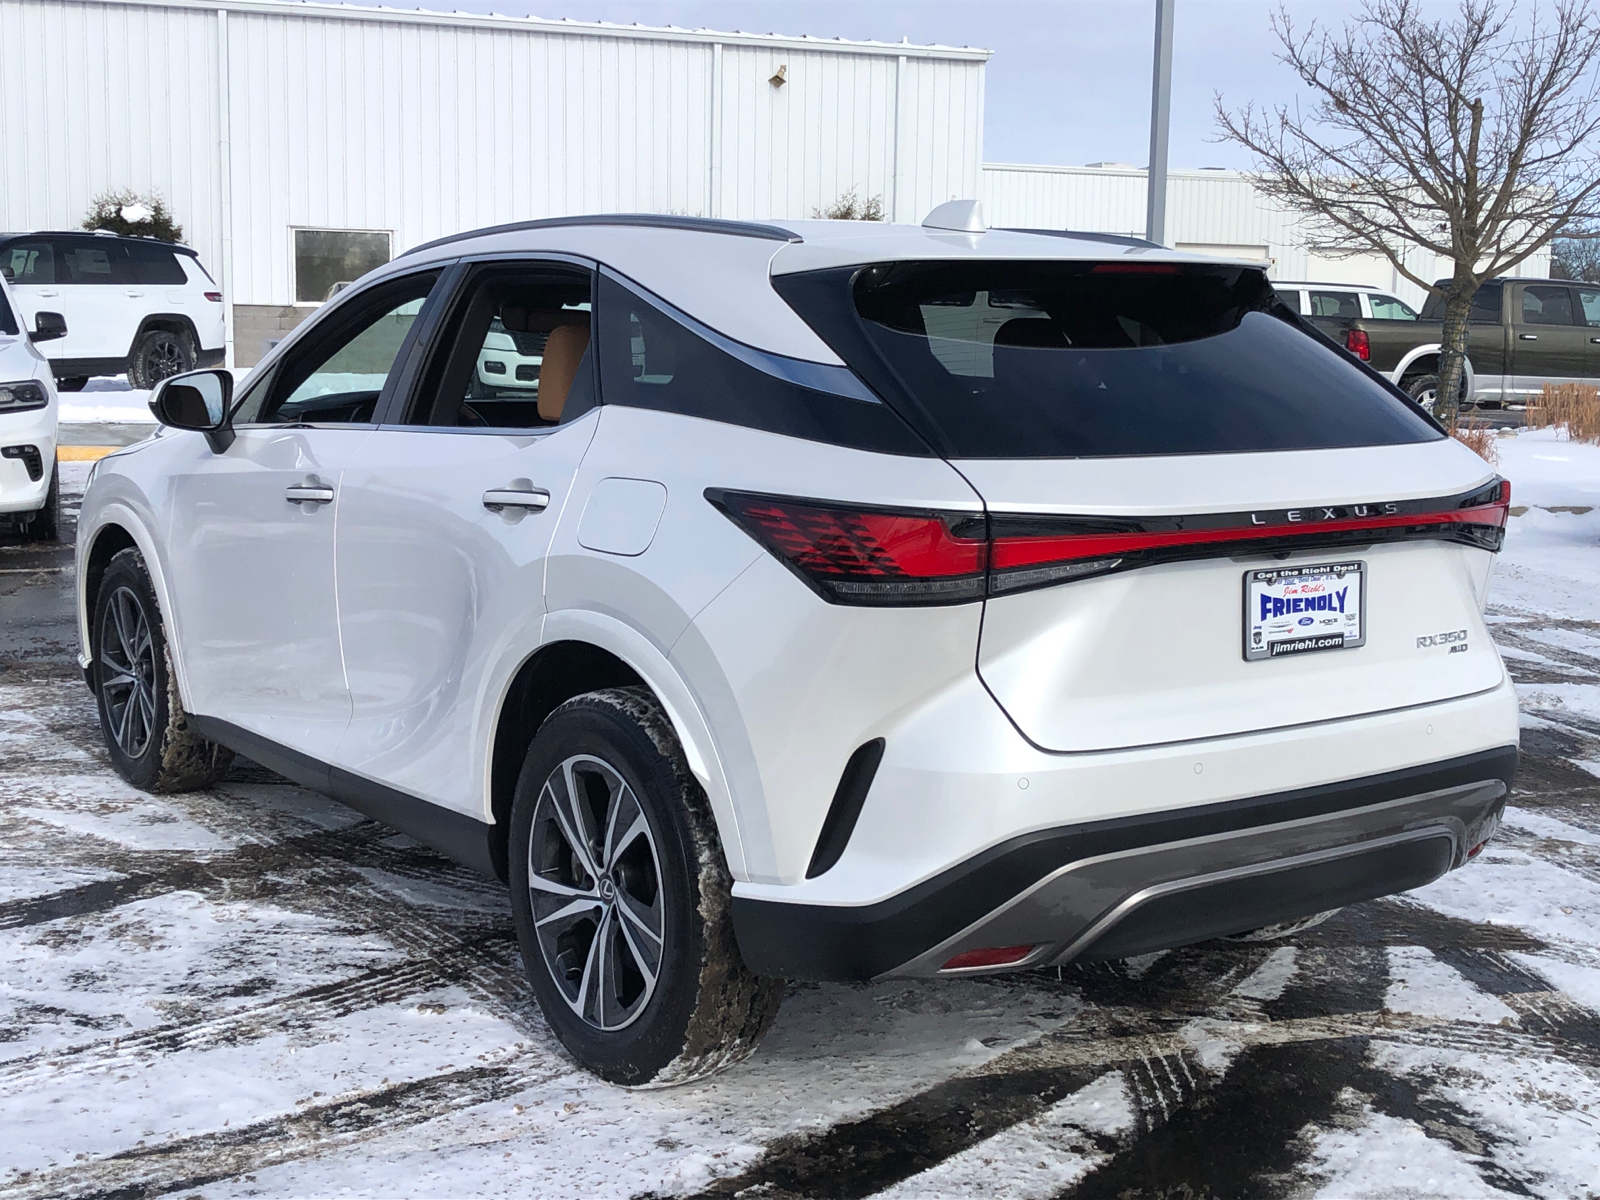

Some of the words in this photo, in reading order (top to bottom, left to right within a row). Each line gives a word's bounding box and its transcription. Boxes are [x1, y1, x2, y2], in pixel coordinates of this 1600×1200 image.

[1251, 503, 1397, 525] LEXUS
[1257, 571, 1278, 579] Get
[1280, 569, 1299, 577] the
[1302, 566, 1330, 575] Riehl
[1333, 564, 1358, 572] Deal
[1283, 586, 1298, 597] Jim
[1300, 583, 1325, 594] Riehl's
[1260, 585, 1349, 622] FRIENDLY
[1272, 637, 1342, 655] jimriehl.com
[1416, 629, 1468, 649] RX350
